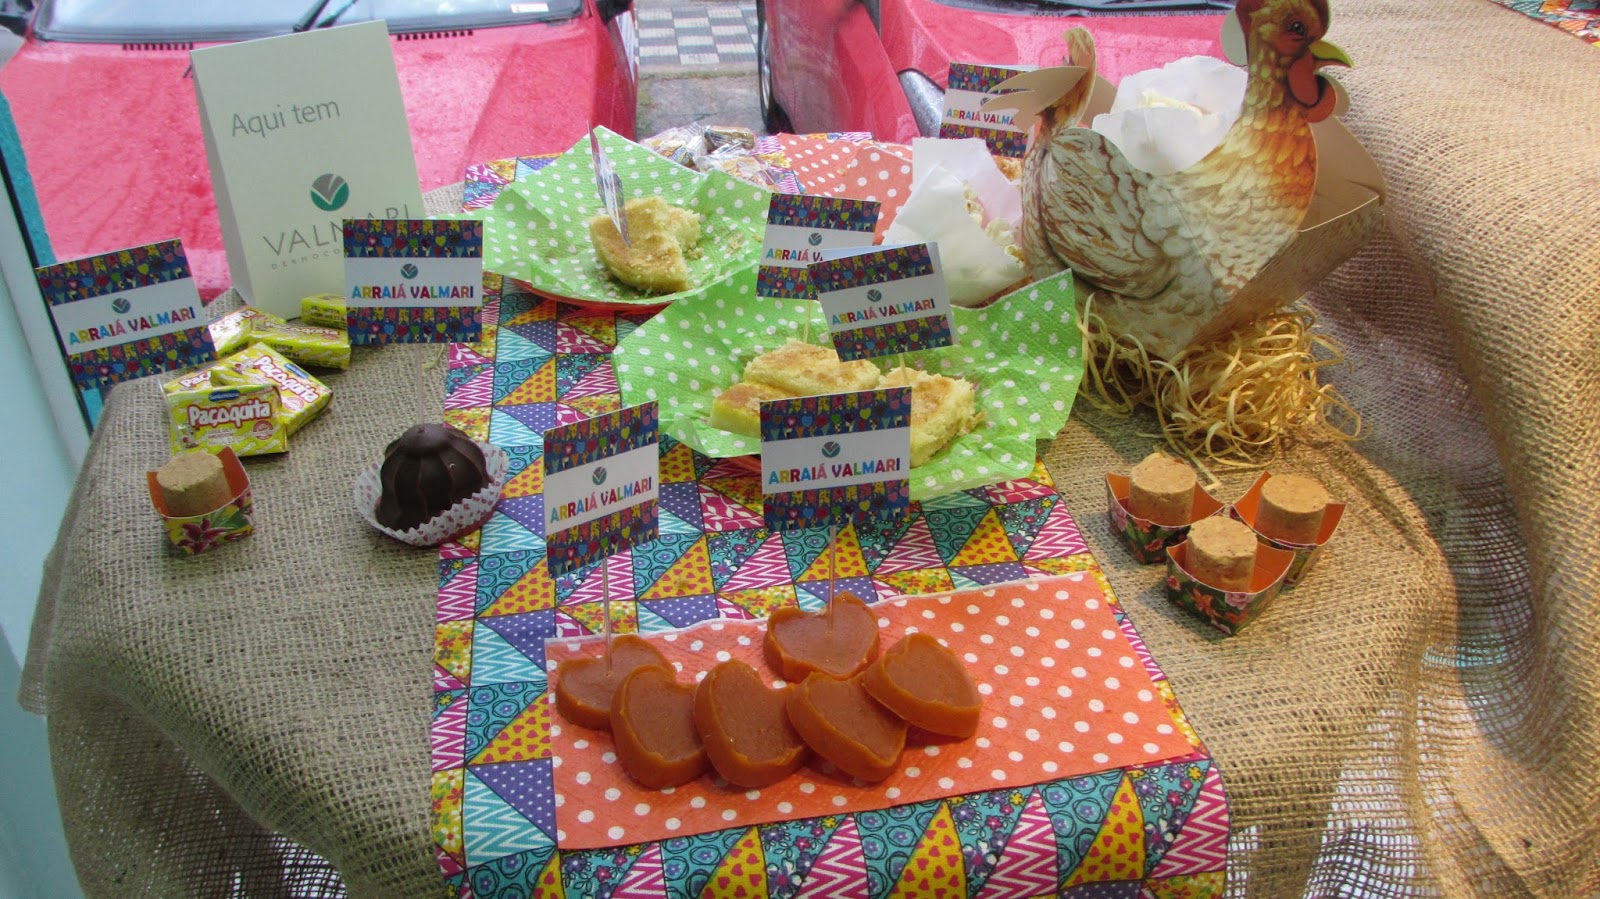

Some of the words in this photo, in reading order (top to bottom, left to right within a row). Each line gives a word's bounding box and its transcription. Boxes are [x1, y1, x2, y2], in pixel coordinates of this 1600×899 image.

[232, 104, 286, 138] Aqui
[291, 101, 341, 125] tem
[766, 248, 810, 262] ARRAIÁ
[352, 283, 407, 299] ARRAIÁ
[410, 285, 474, 299] VALMARI
[69, 318, 127, 346] ARRAIÁ
[127, 306, 196, 332] VALMARI
[832, 306, 878, 326] ARRAIÁ
[879, 298, 936, 317] VALMARI
[253, 355, 321, 404] Paçoquita
[188, 399, 272, 429] Paçoquita
[768, 463, 828, 484] ARRAIÁ
[831, 458, 900, 478] VALMARI
[550, 492, 598, 523] ARRAIÁ
[600, 477, 652, 506] VALMARI
